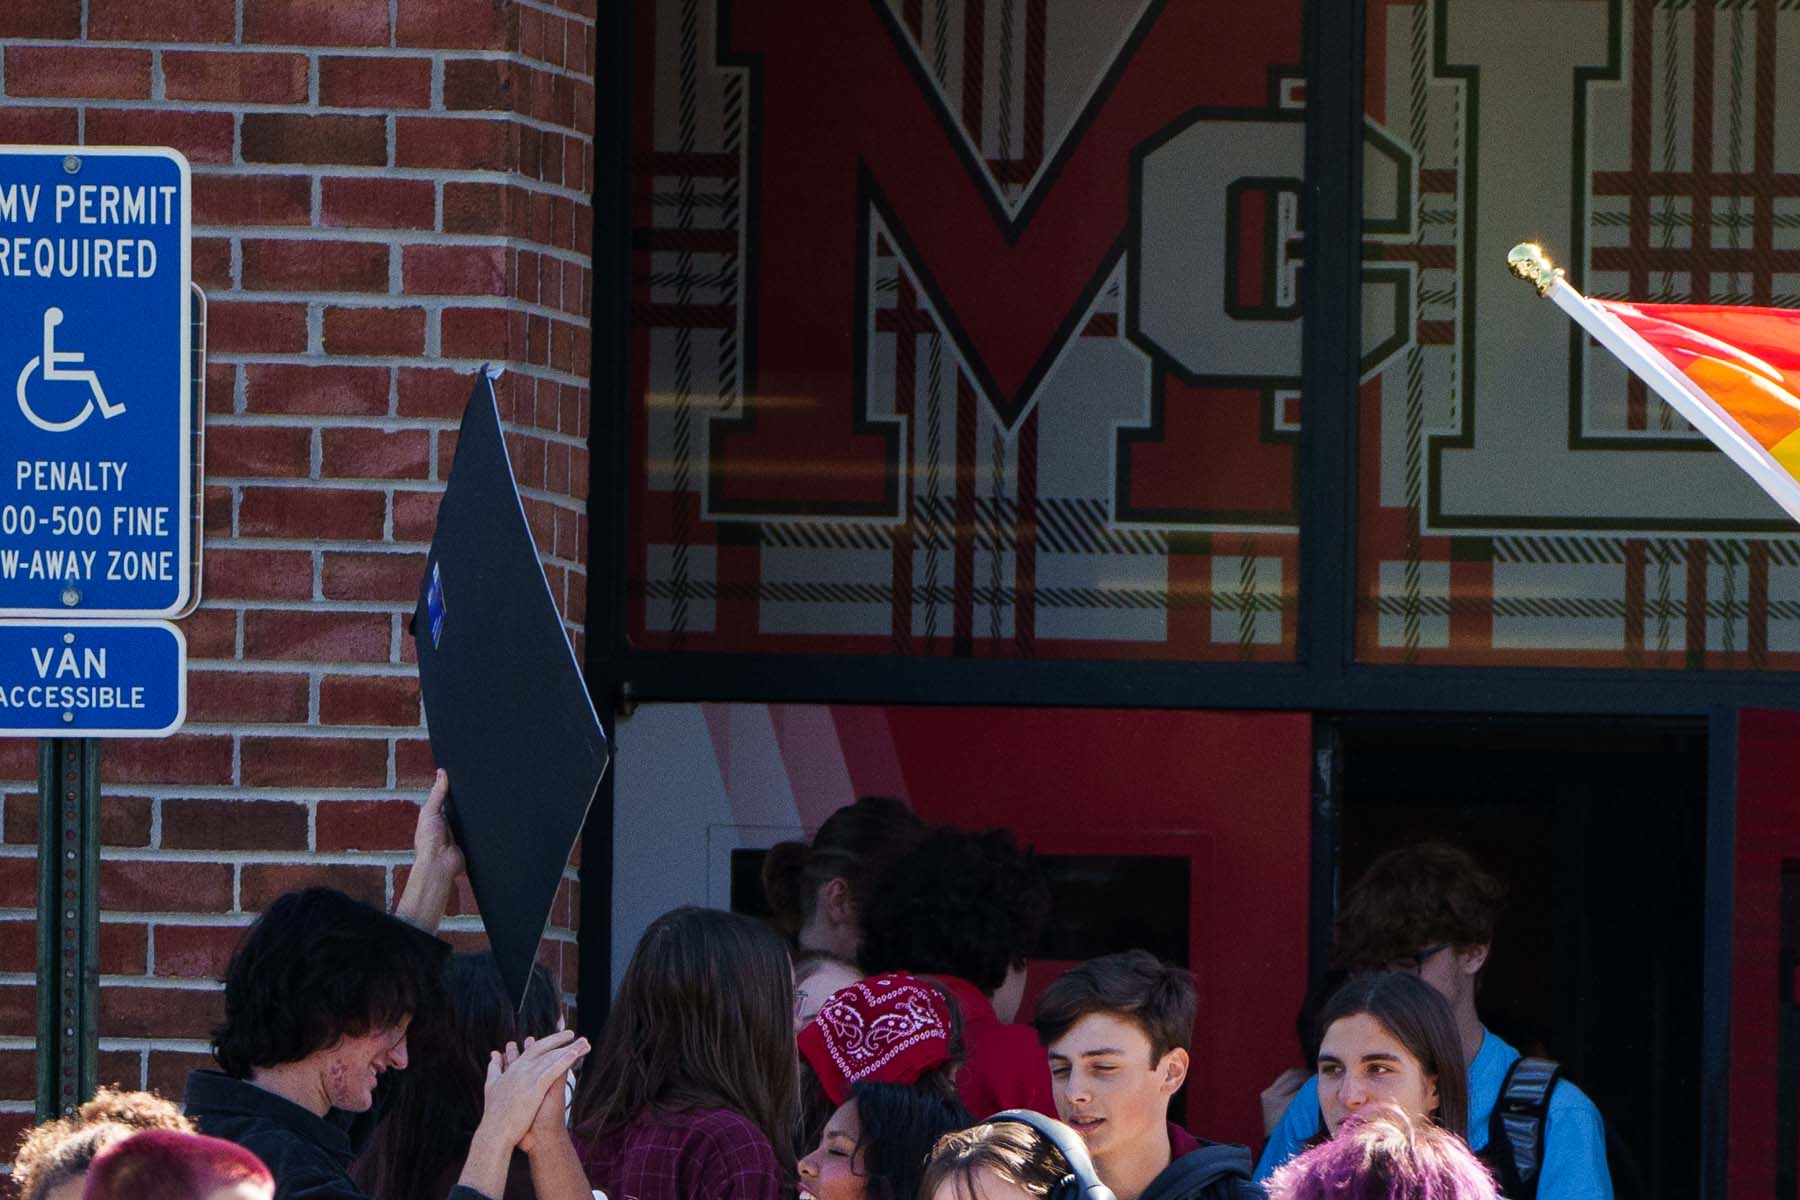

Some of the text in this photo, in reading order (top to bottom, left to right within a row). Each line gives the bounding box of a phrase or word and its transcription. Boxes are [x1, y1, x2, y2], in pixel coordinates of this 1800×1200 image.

[55, 184, 177, 224] PERMIT
[0, 237, 157, 278] REQUIRED
[16, 461, 128, 491] PENALTY
[2, 505, 169, 536] 00-500 FINE
[0, 550, 173, 581] W-AWAY ZONE
[31, 647, 107, 679] VAN
